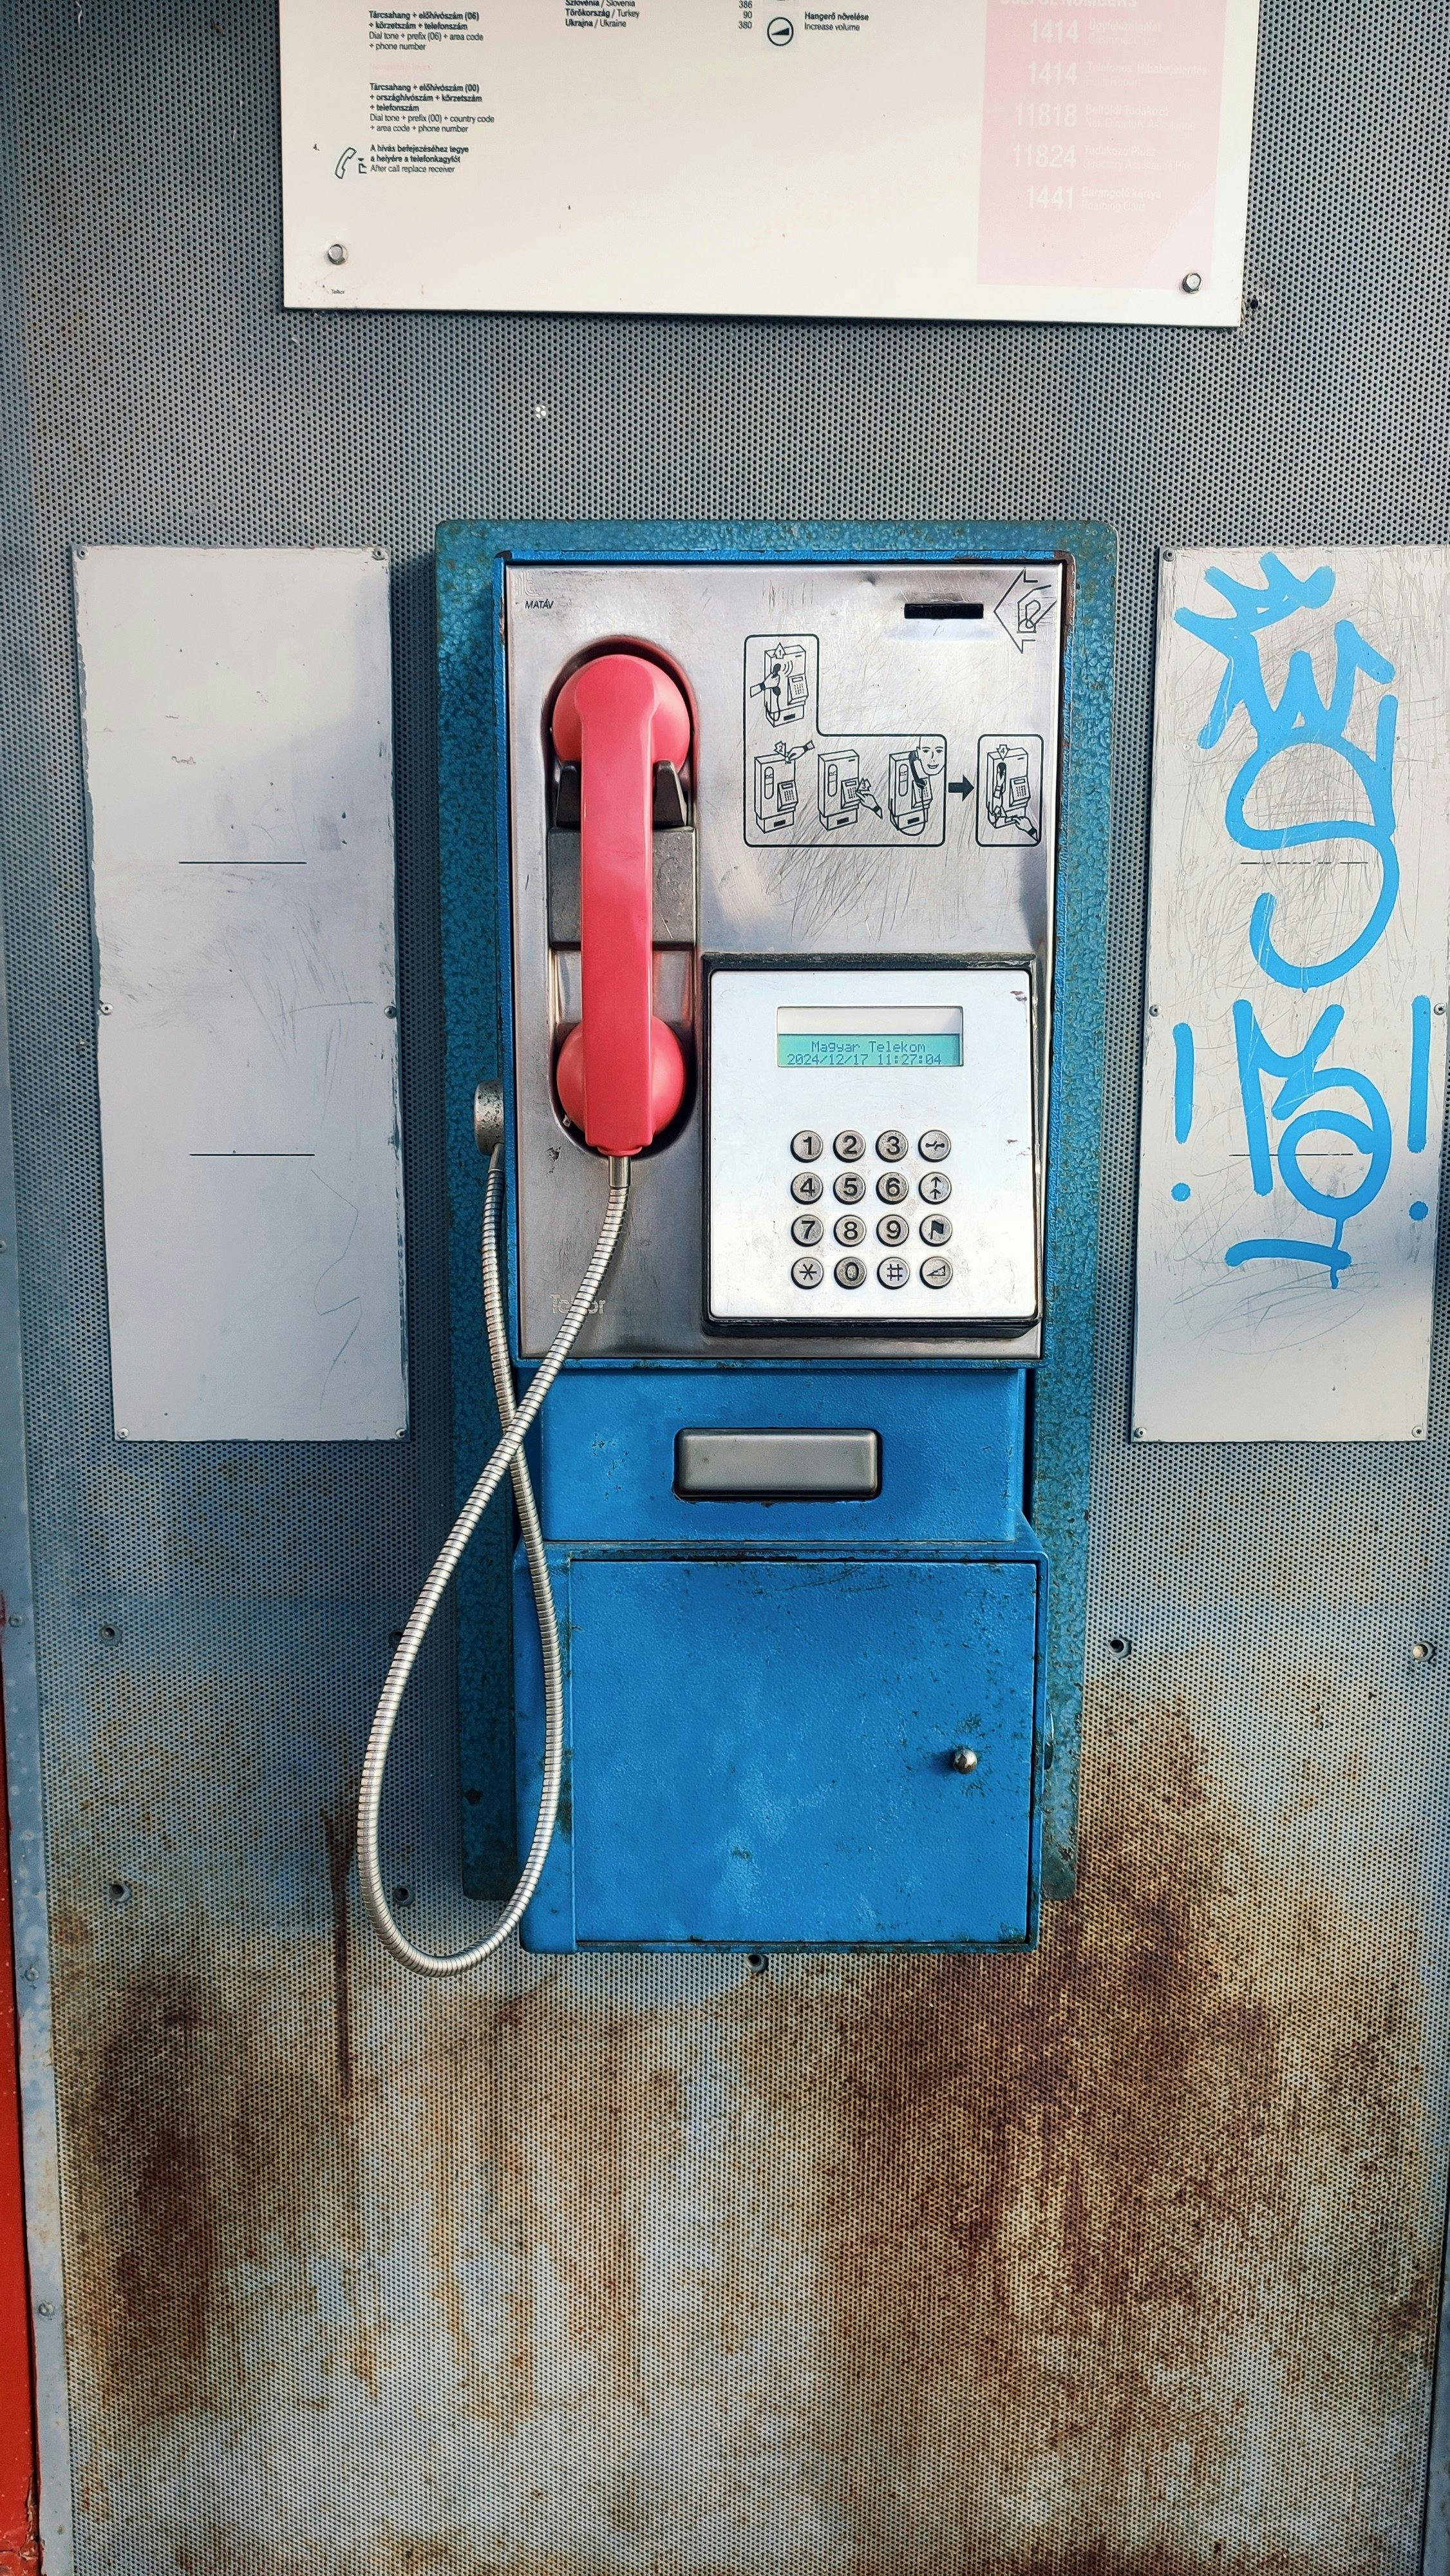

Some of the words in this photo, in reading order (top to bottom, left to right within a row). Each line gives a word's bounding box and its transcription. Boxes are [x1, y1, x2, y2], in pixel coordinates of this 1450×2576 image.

[369, 10, 410, 20] Tárcsahang
[465, 12, 479, 21] (06)
[617, 9, 639, 19] Turkey
[375, 21, 416, 30] körzetszám
[565, 19, 593, 28] Ukrajna
[804, 22, 833, 30] Increase
[834, 23, 860, 31] volume
[407, 32, 426, 41] prefix
[428, 32, 442, 42] (06)
[1031, 19, 1080, 44] 1414
[375, 42, 397, 50] phone
[1030, 61, 1077, 85] 1414
[370, 82, 411, 92] Tárcsahang
[465, 84, 479, 93] (00)
[408, 114, 426, 123] prefix
[428, 114, 442, 124] (00)
[450, 115, 476, 124] country
[1015, 102, 1077, 126] 11818
[419, 125, 440, 133] phone
[449, 145, 469, 154] tegye
[1013, 144, 1076, 168] 11824
[402, 165, 426, 173] replace
[1027, 185, 1073, 209] 1441
[525, 598, 554, 609] MATÁV
[811, 1041, 860, 1053] Magyar
[869, 1041, 925, 1053] Telekom
[787, 1054, 869, 1065] 2024/12/17
[878, 1054, 942, 1065] 11:27:04
[802, 1136, 813, 1155] 1
[843, 1135, 857, 1155] 2
[887, 1135, 900, 1155] 3
[800, 1177, 815, 1197] 4
[843, 1177, 858, 1196] 5
[885, 1177, 900, 1197] 6
[801, 1220, 816, 1240] 7
[843, 1221, 858, 1240] 8
[886, 1220, 901, 1240] 9
[845, 1261, 860, 1282] 0
[550, 1294, 606, 1314] Teor
